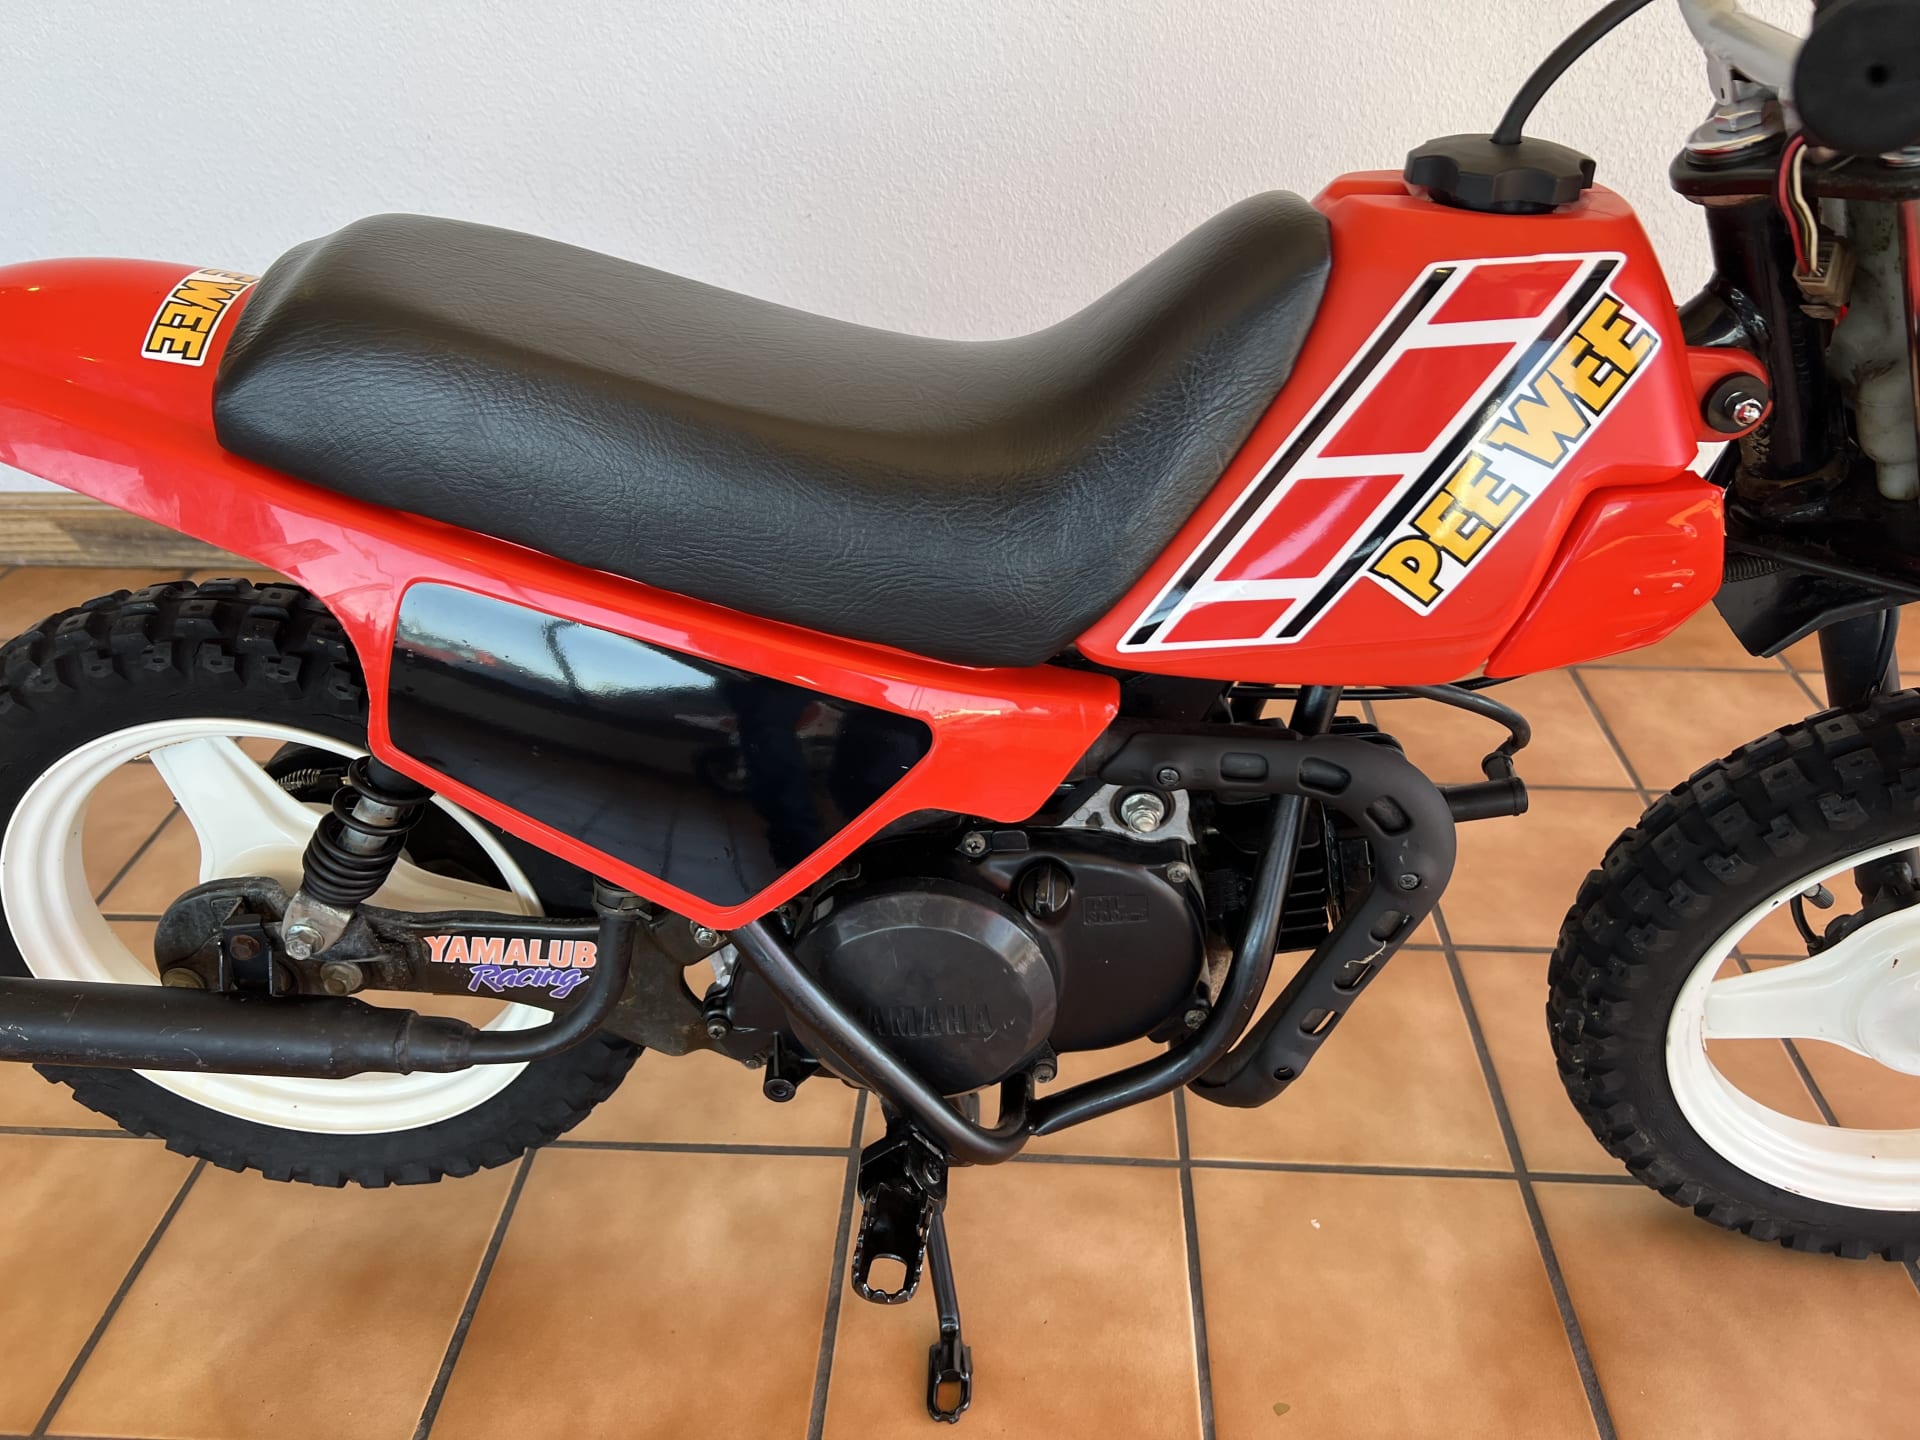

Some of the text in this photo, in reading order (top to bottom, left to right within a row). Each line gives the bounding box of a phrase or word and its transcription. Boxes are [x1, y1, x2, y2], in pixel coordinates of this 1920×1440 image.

[145, 279, 248, 361] WEE
[1368, 292, 1659, 607] PEE WEE
[467, 964, 590, 999] Racing
[855, 1003, 993, 1037] AMAHA
